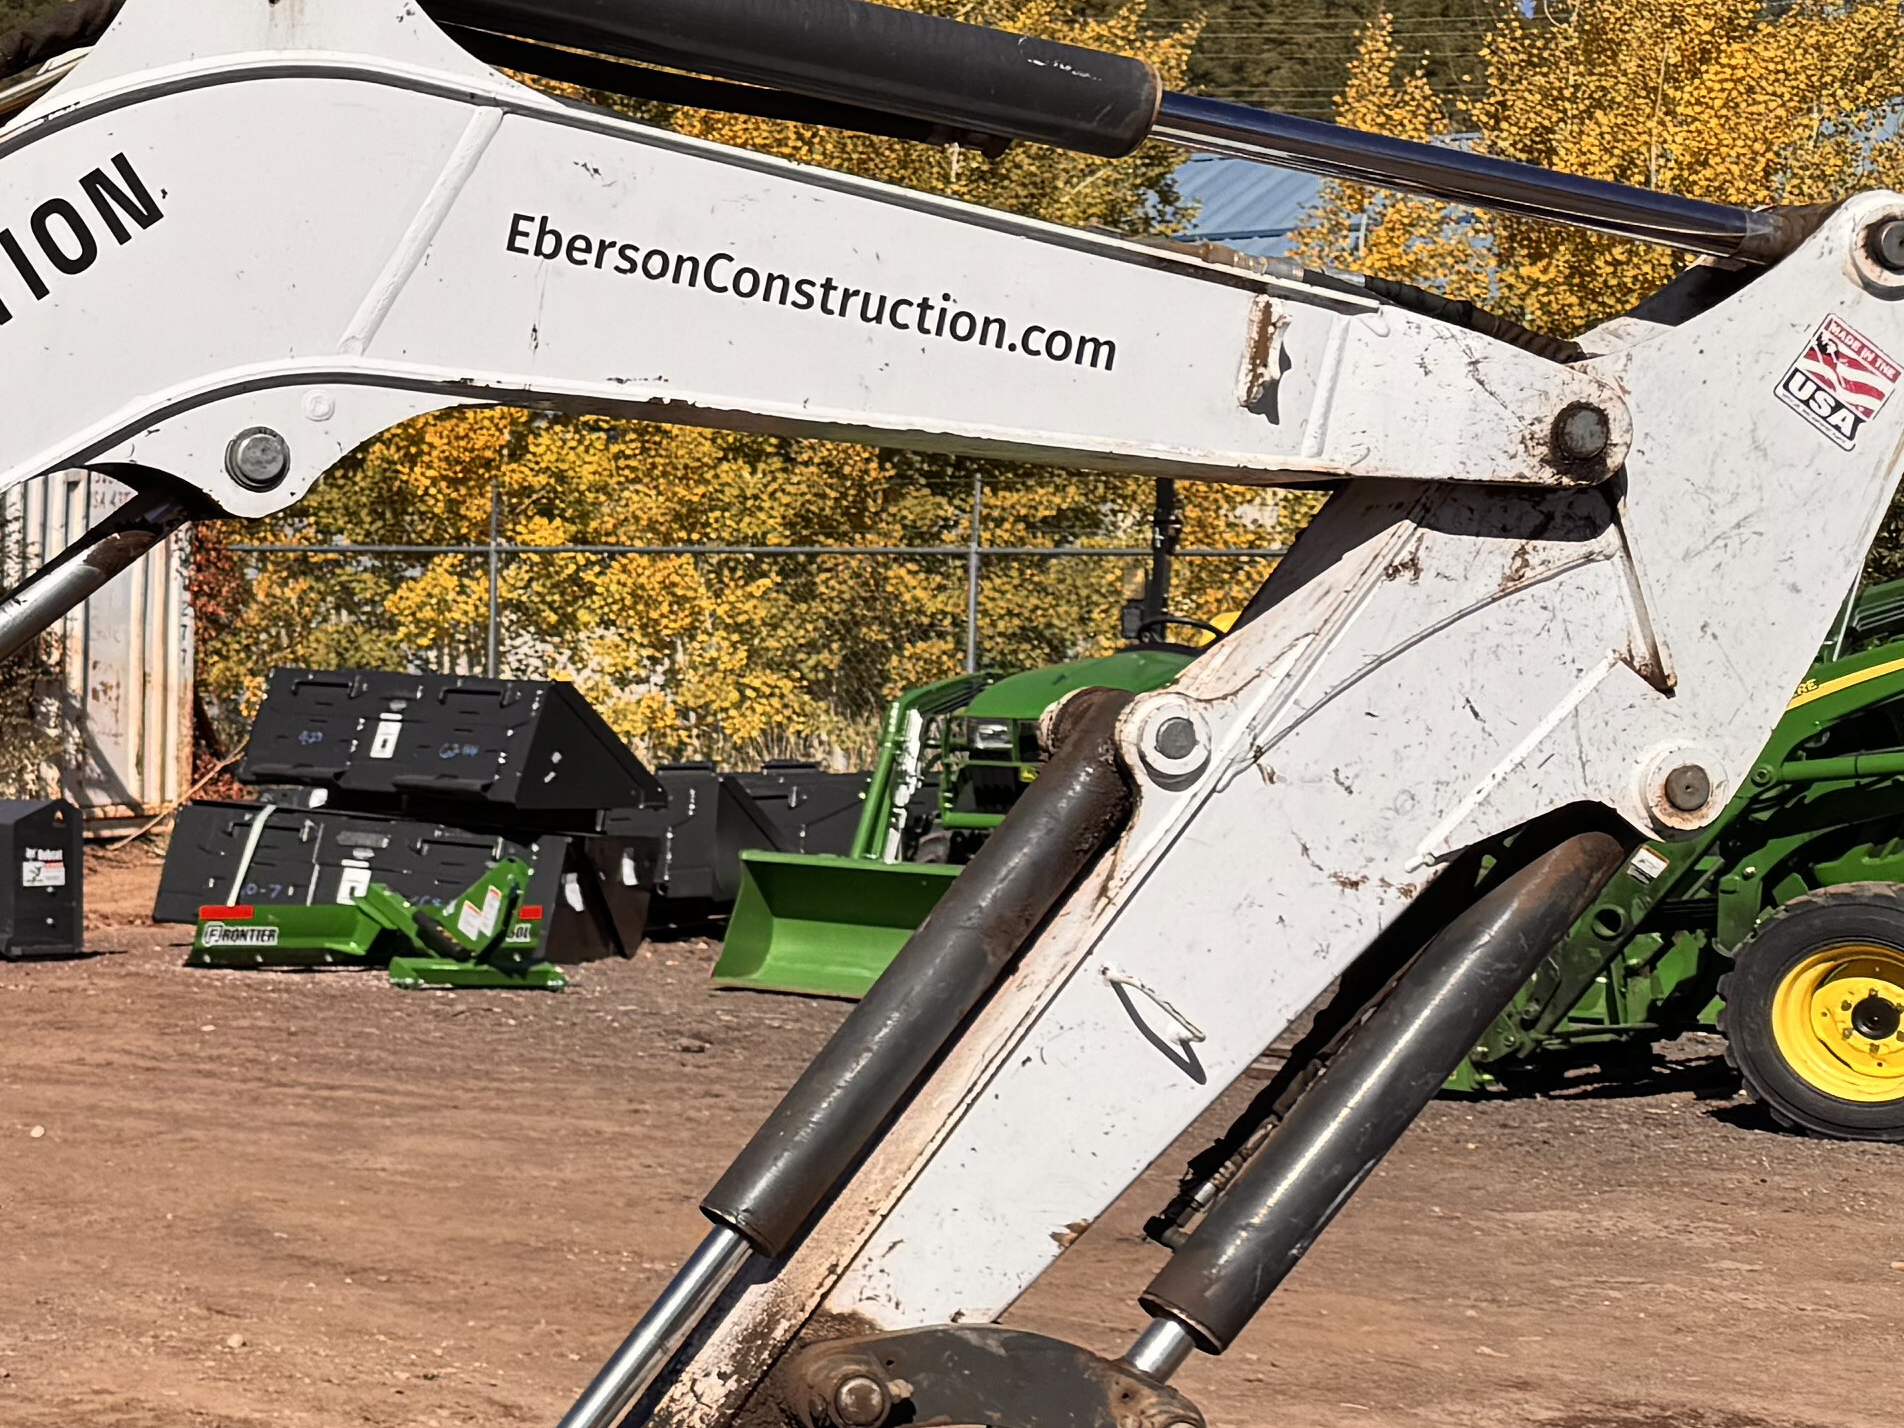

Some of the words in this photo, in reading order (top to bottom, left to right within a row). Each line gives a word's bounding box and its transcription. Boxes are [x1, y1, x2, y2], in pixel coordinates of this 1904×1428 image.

[506, 213, 1117, 371] EbersonConstruction.com
[1828, 321, 1863, 353] MADE
[1860, 347, 1876, 362] IN
[1874, 358, 1897, 381] THE
[1788, 371, 1856, 438] USA
[204, 922, 277, 945] FRONTIER
